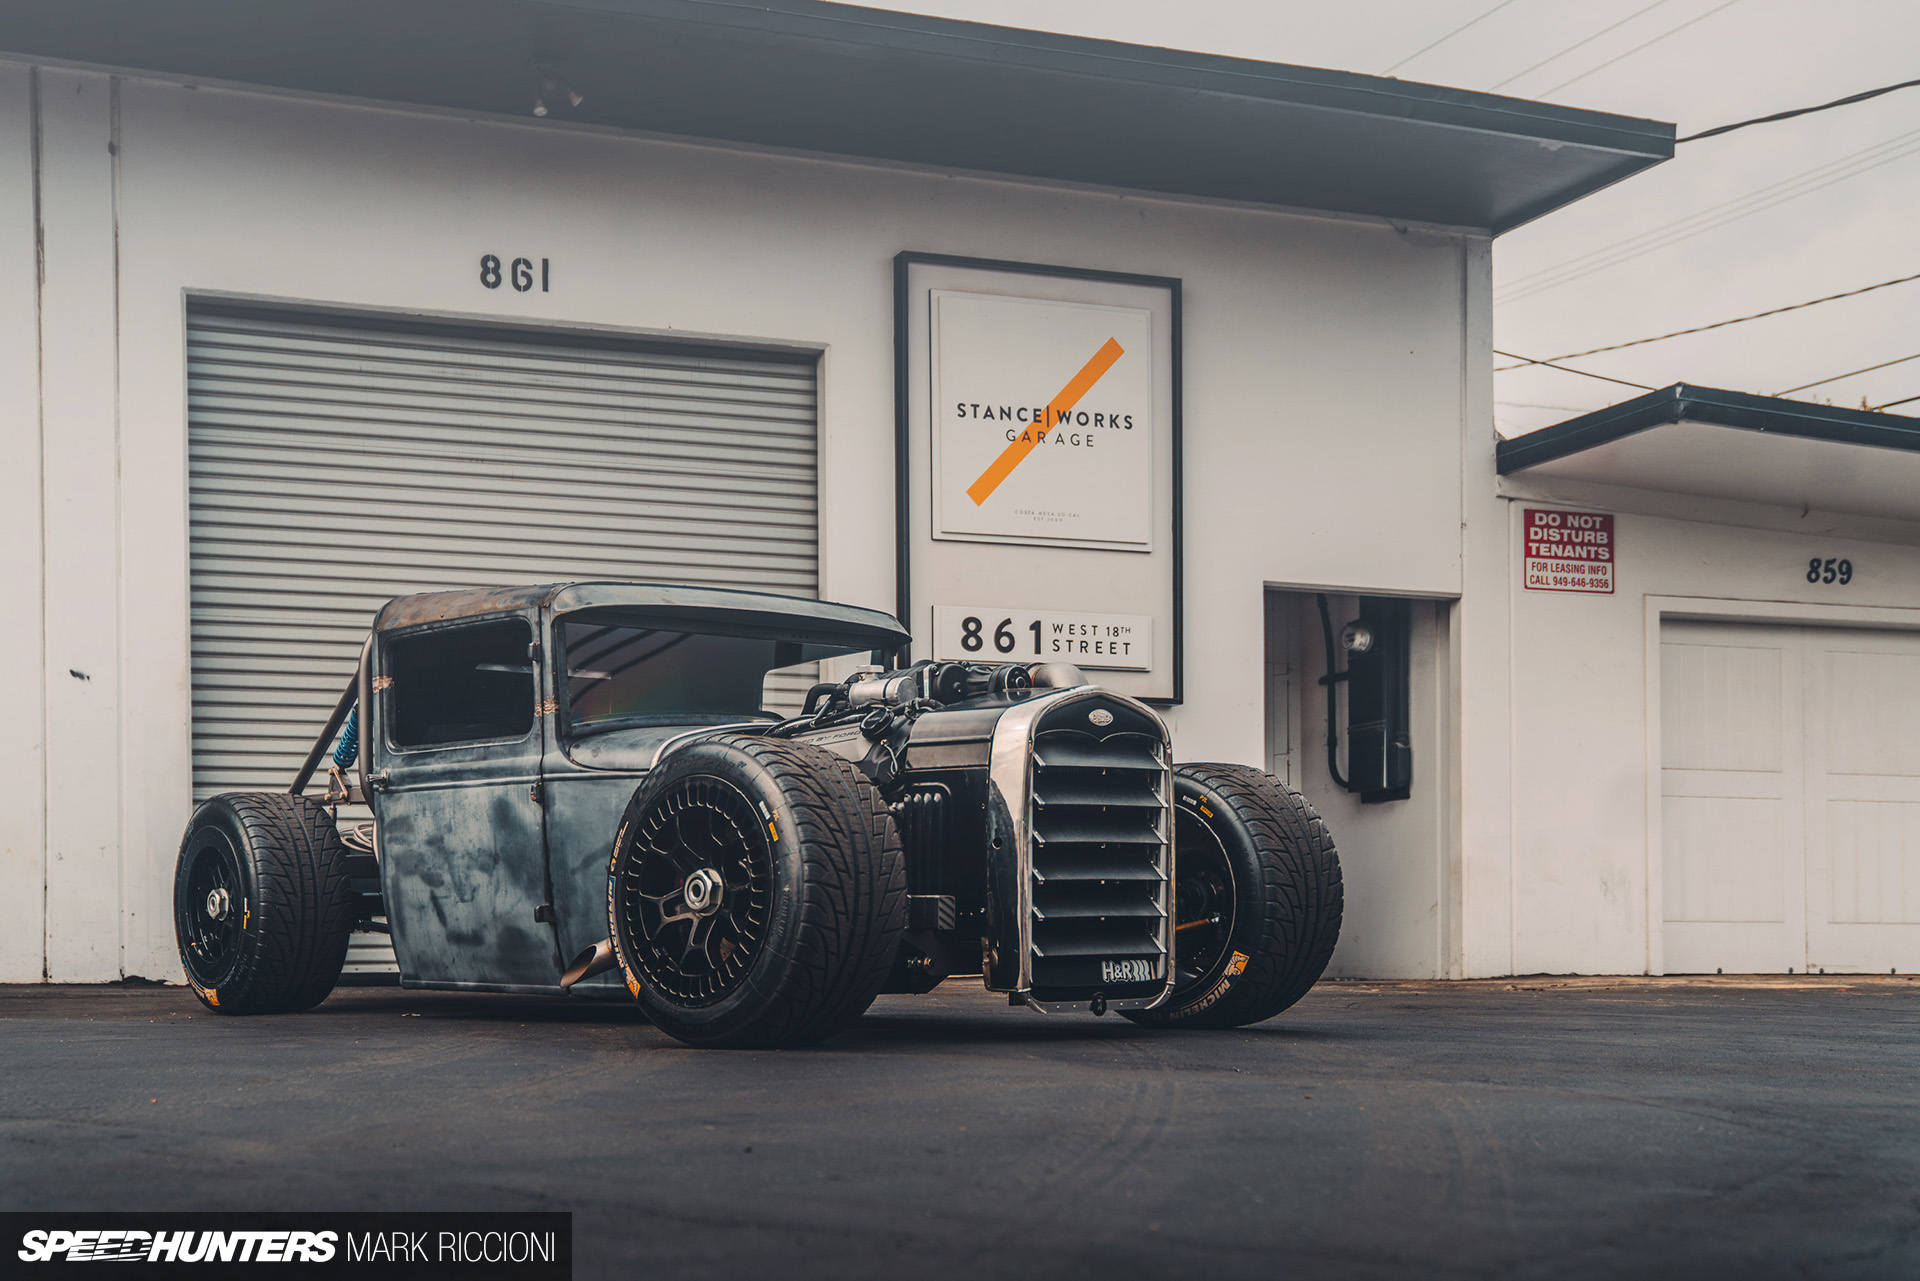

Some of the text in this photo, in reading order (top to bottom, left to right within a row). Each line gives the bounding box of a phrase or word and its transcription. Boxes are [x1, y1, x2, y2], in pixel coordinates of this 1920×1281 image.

[480, 254, 549, 292] 861
[1005, 429, 1094, 448] GARAGE
[1535, 512, 1603, 529] DO NOT
[1529, 527, 1608, 544] DISTURB
[1528, 542, 1610, 560] TENANTS
[1531, 561, 1608, 576] FOR LEASING INFO
[1806, 557, 1853, 586] 859
[1529, 574, 1609, 589] CALL 949-646-9356
[960, 616, 1042, 655] 861
[1052, 623, 1131, 637] WEST 18TH
[1052, 639, 1131, 655] STREET
[1102, 960, 1135, 983] H&R
[1169, 978, 1231, 1020] MICHELIN
